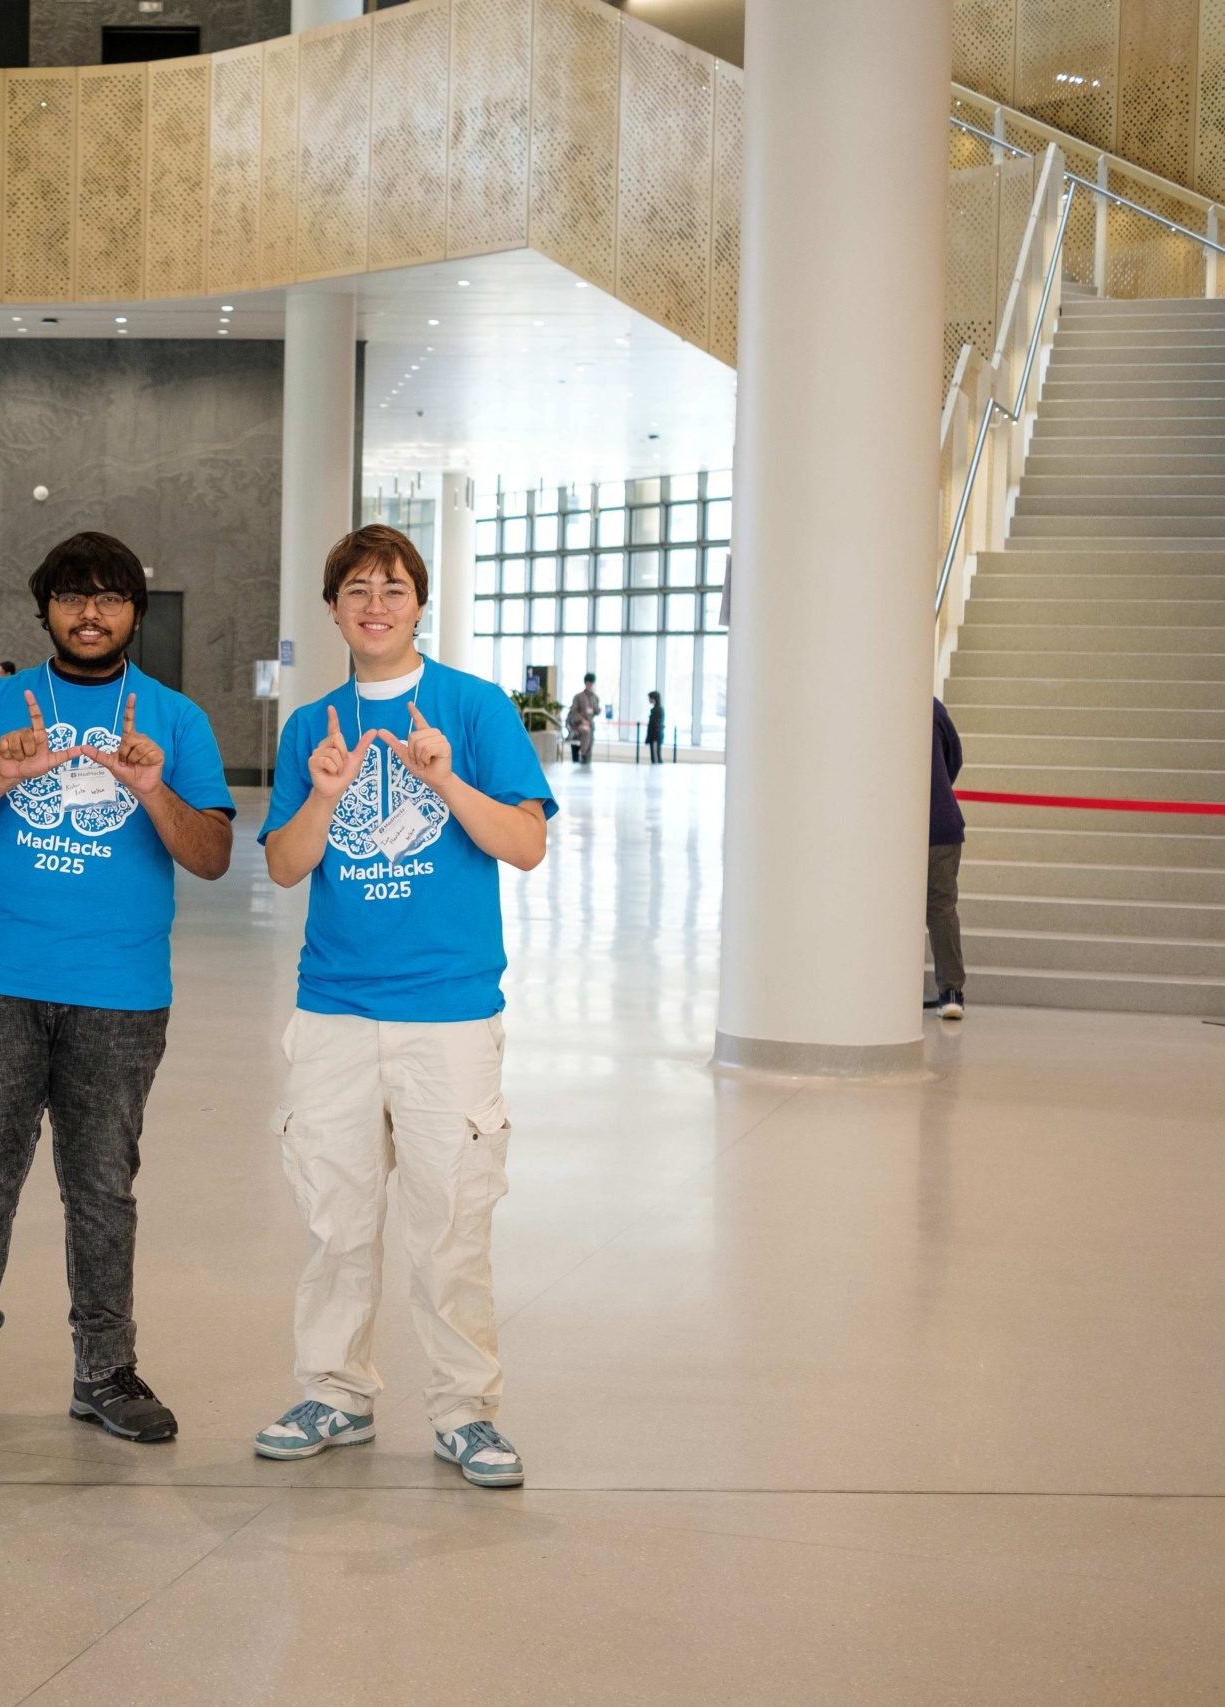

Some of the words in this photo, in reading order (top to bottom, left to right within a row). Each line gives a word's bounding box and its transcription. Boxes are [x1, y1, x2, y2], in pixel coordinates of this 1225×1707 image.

[383, 807, 405, 828] MadHacks
[16, 829, 112, 858] MadHacks
[34, 853, 85, 875] 2025
[339, 859, 434, 881] MadHacks
[363, 881, 412, 901] 2025
